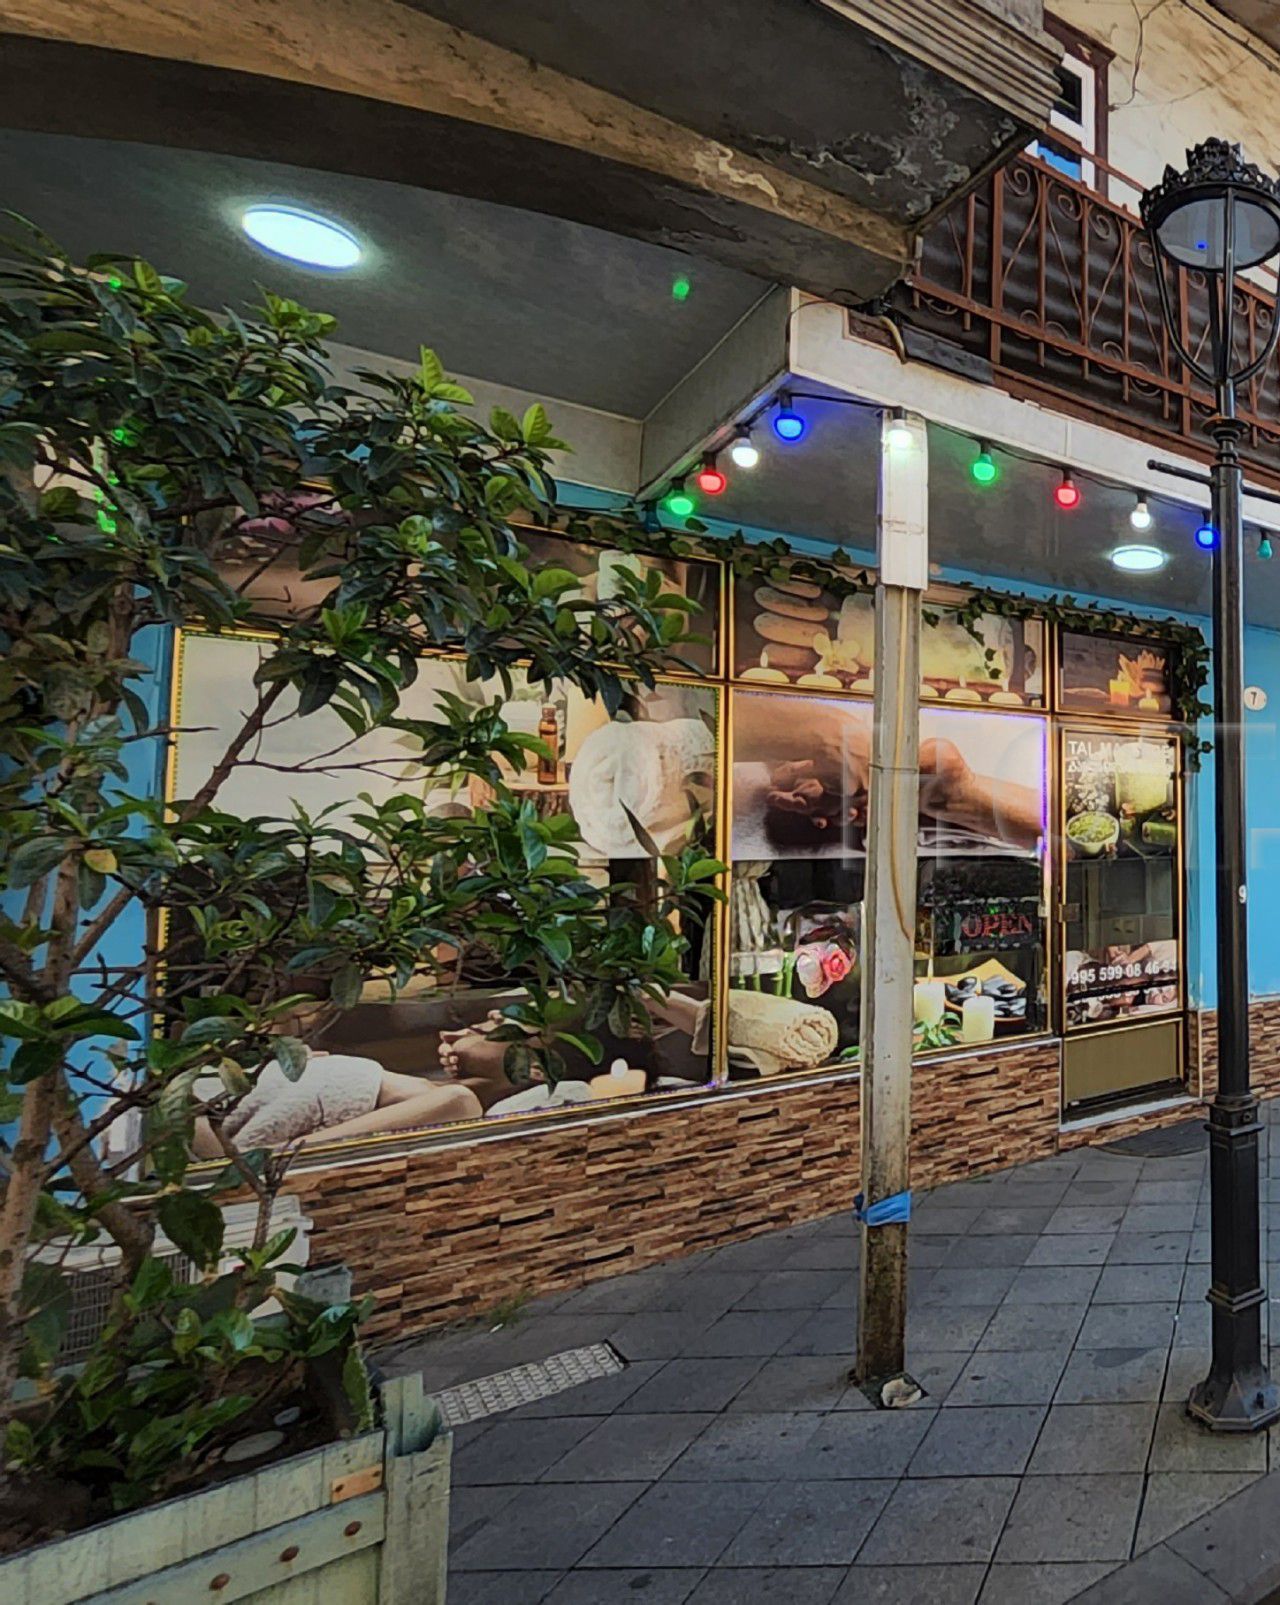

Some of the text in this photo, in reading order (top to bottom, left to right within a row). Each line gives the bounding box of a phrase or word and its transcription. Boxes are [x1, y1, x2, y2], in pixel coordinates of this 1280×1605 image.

[1250, 691, 1258, 706] 7
[961, 912, 1033, 938] OPEN
[1099, 965, 1123, 981] 599
[1126, 962, 1142, 978] 08
